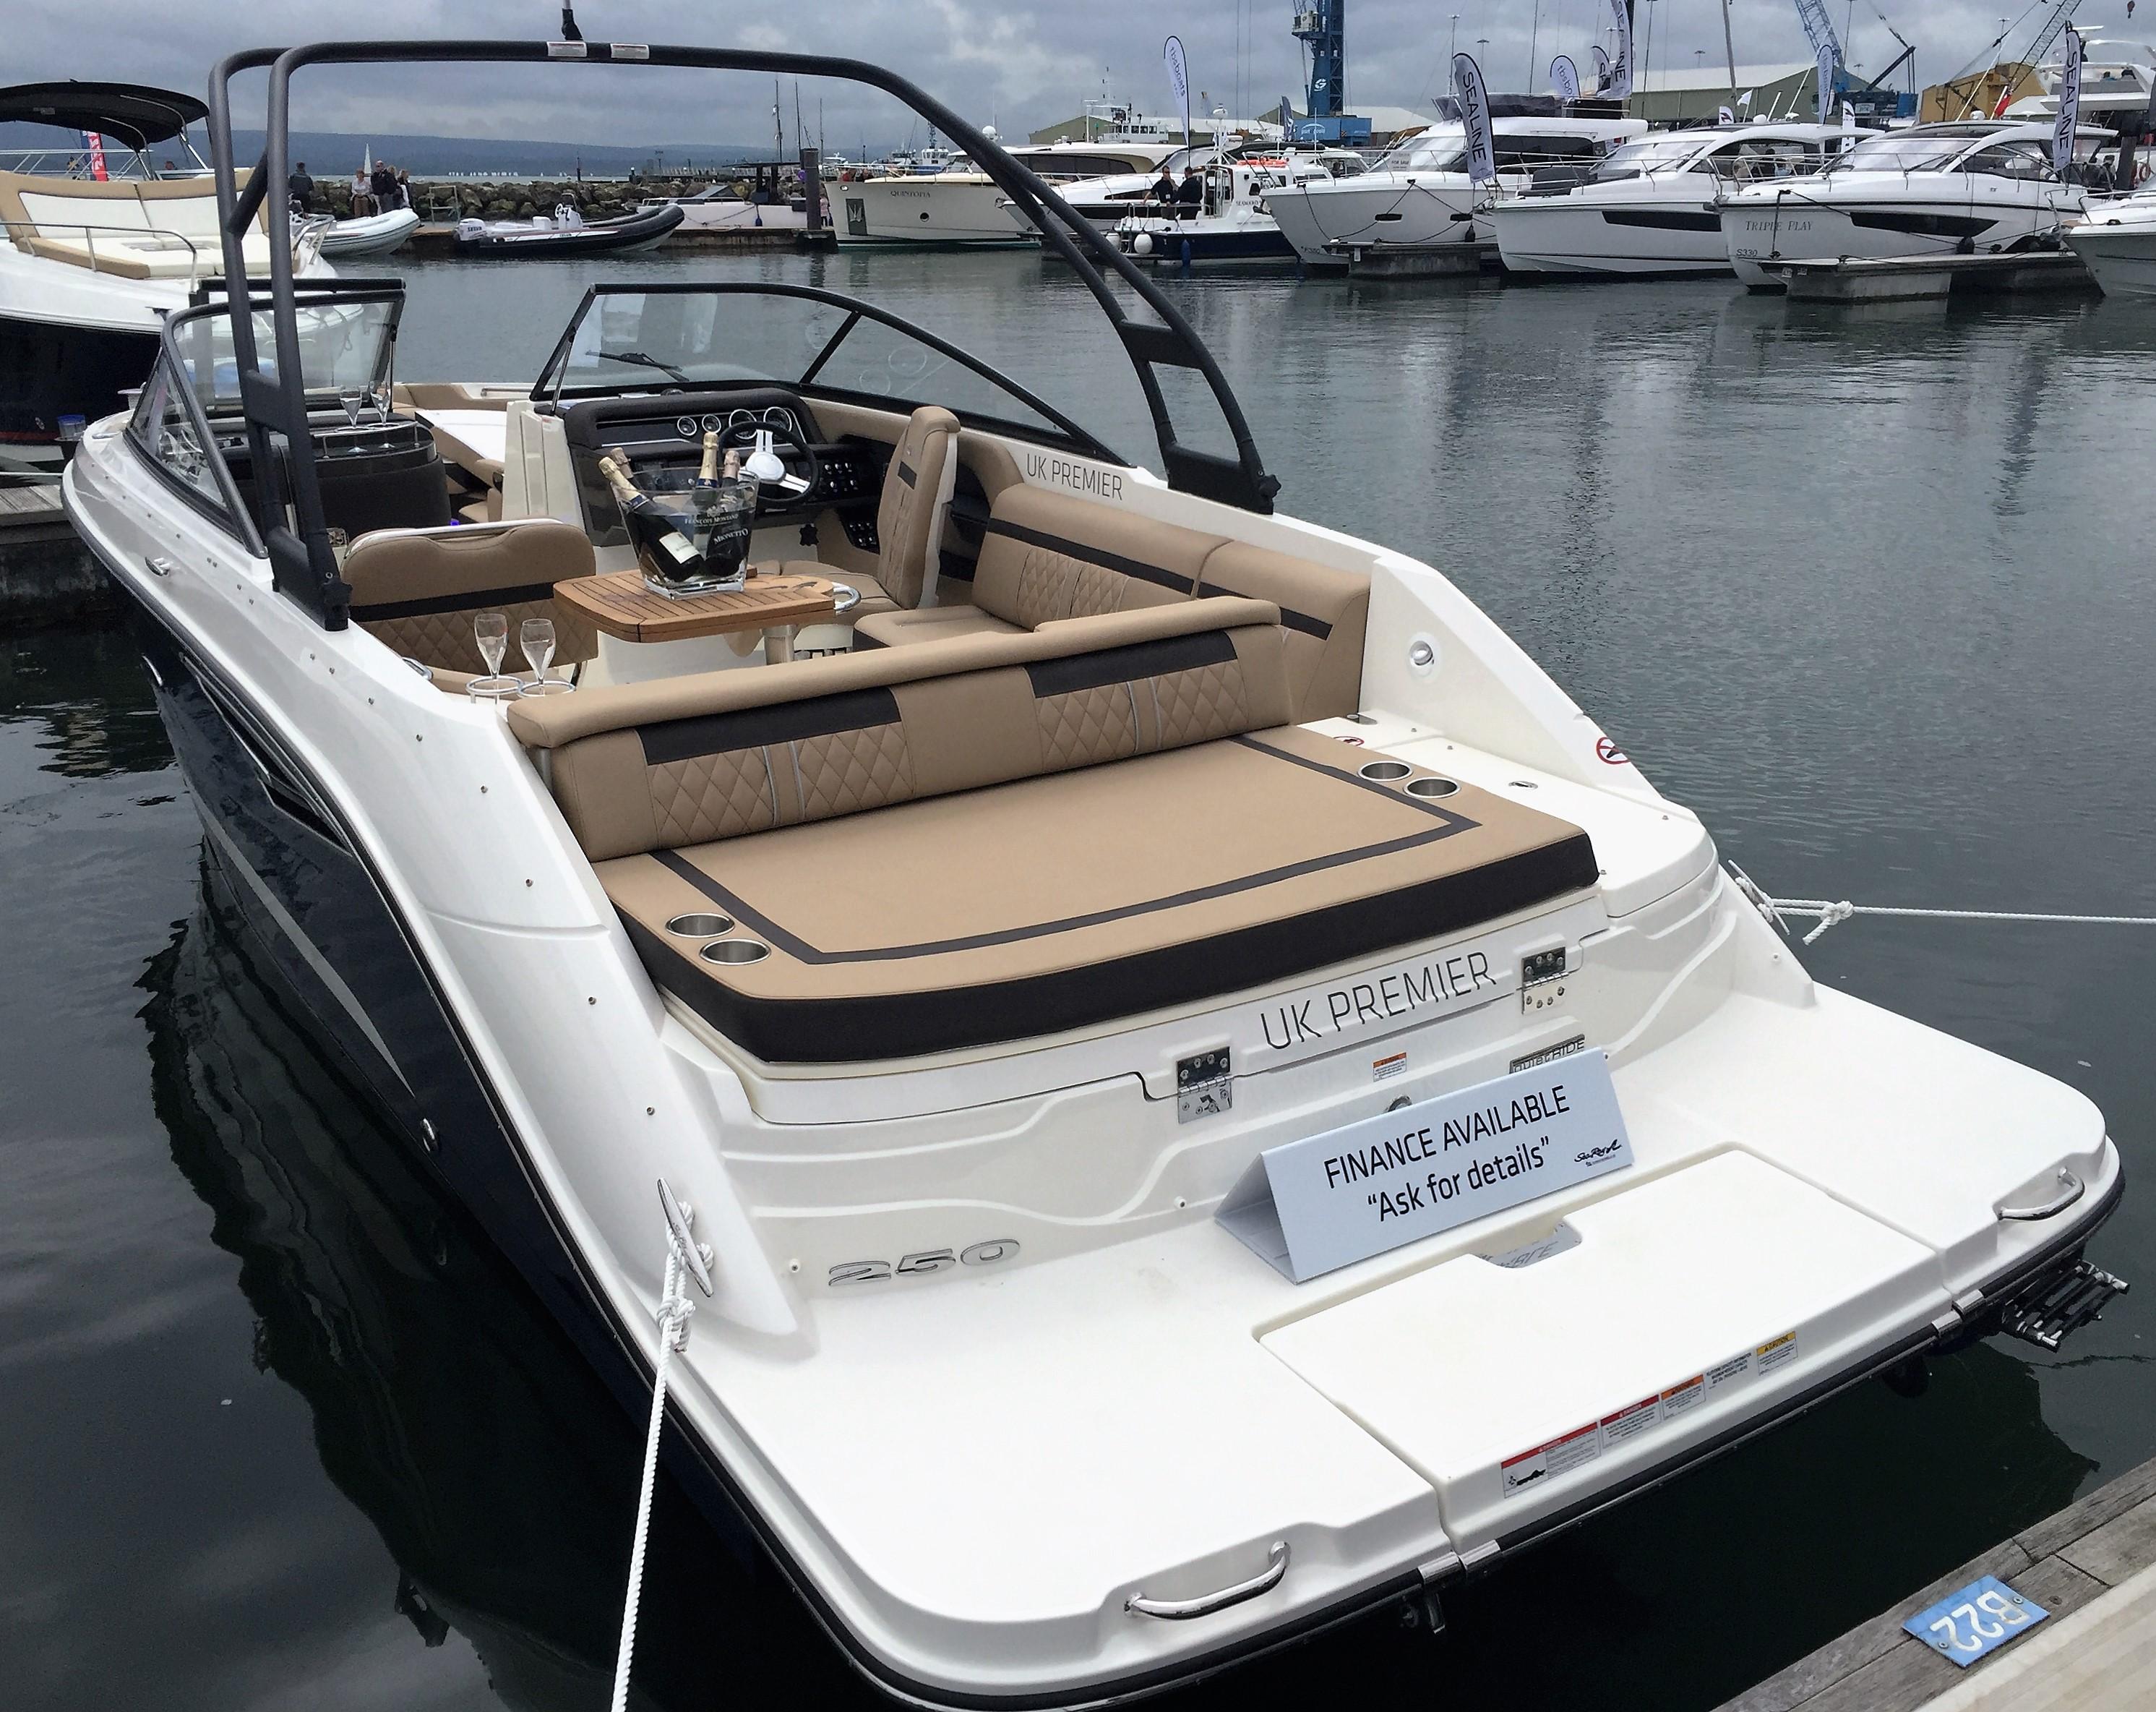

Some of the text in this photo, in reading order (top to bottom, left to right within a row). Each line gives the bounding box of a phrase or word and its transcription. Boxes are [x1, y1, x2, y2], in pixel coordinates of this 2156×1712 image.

[1463, 72, 1487, 163] SEALINE
[2059, 51, 2077, 150] SEALINE
[1736, 248, 1758, 257] S330
[1746, 220, 1813, 231] TRIPLE PLAY
[1026, 453, 1122, 501] UK PREMIER
[1260, 951, 1498, 1050] UK PREMIER
[1323, 1084, 1571, 1189] FINANCE AVAILABLE
[1367, 1135, 1550, 1223] “Ask for details”
[828, 1238, 1021, 1287] 250
[1930, 1590, 2030, 1651] B22
